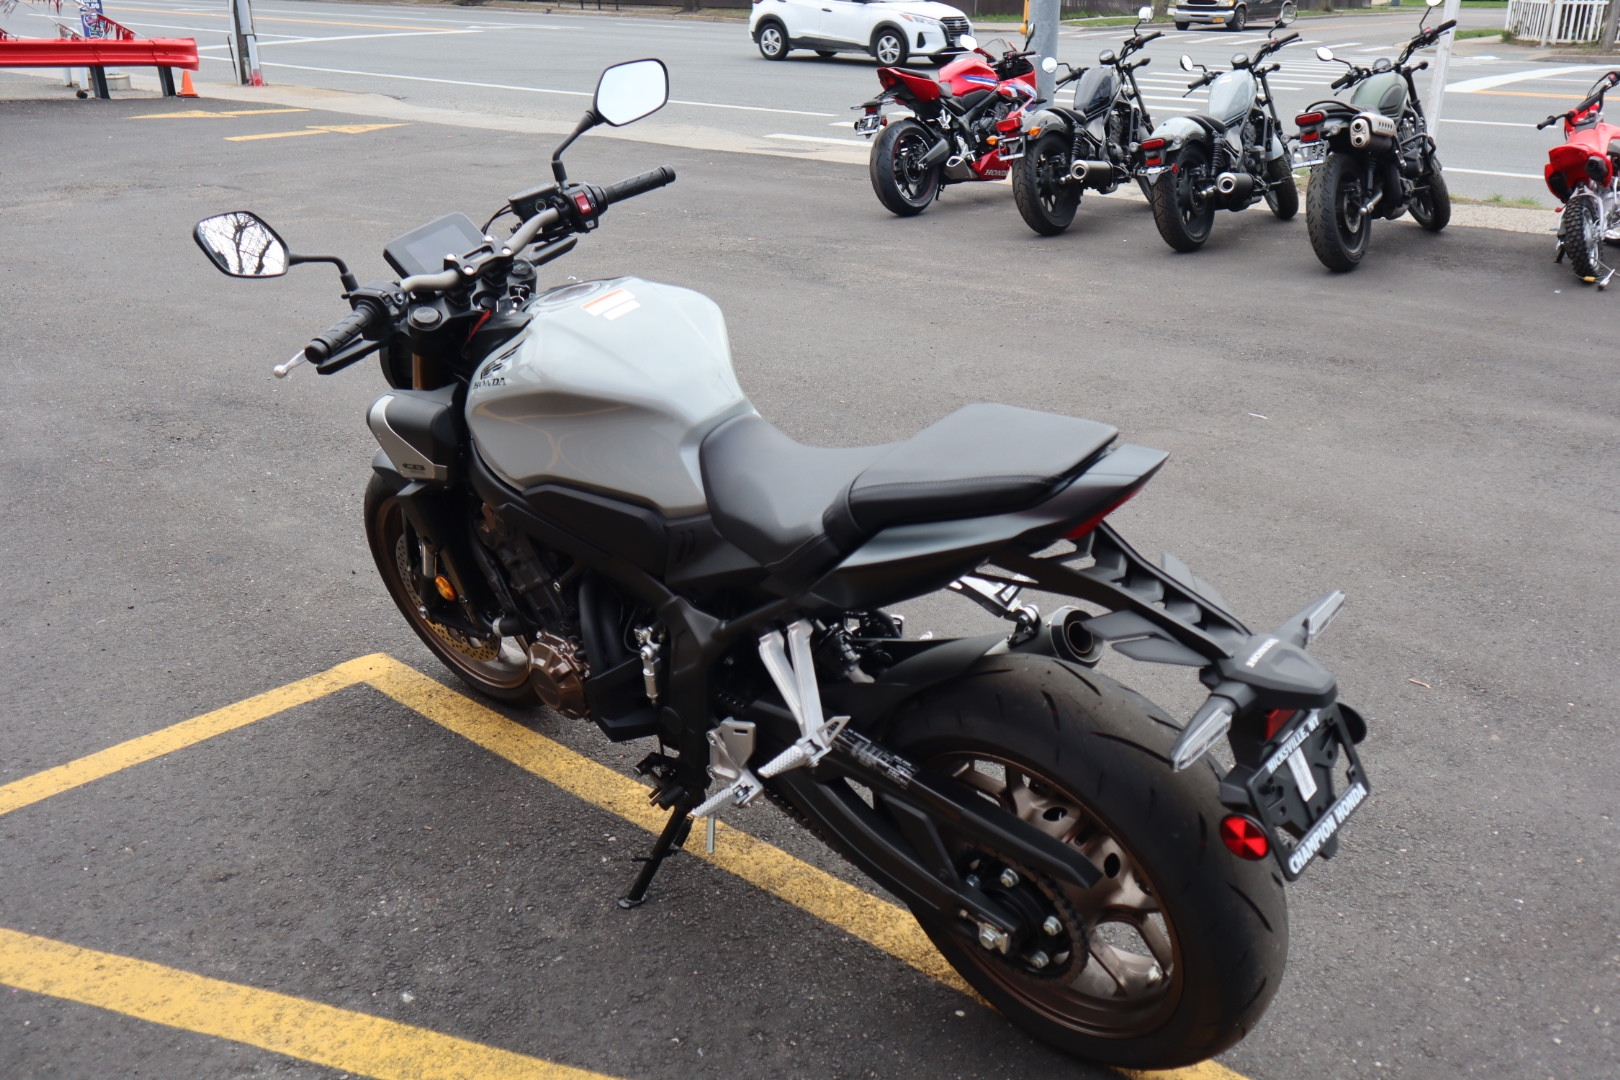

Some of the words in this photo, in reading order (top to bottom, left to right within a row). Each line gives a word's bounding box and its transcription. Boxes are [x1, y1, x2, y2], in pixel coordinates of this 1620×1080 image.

[473, 378, 507, 390] HONDA
[1266, 727, 1310, 774] HICKSVILLE,
[1288, 813, 1337, 874] CHAMPION
[1333, 782, 1368, 824] HONDA
